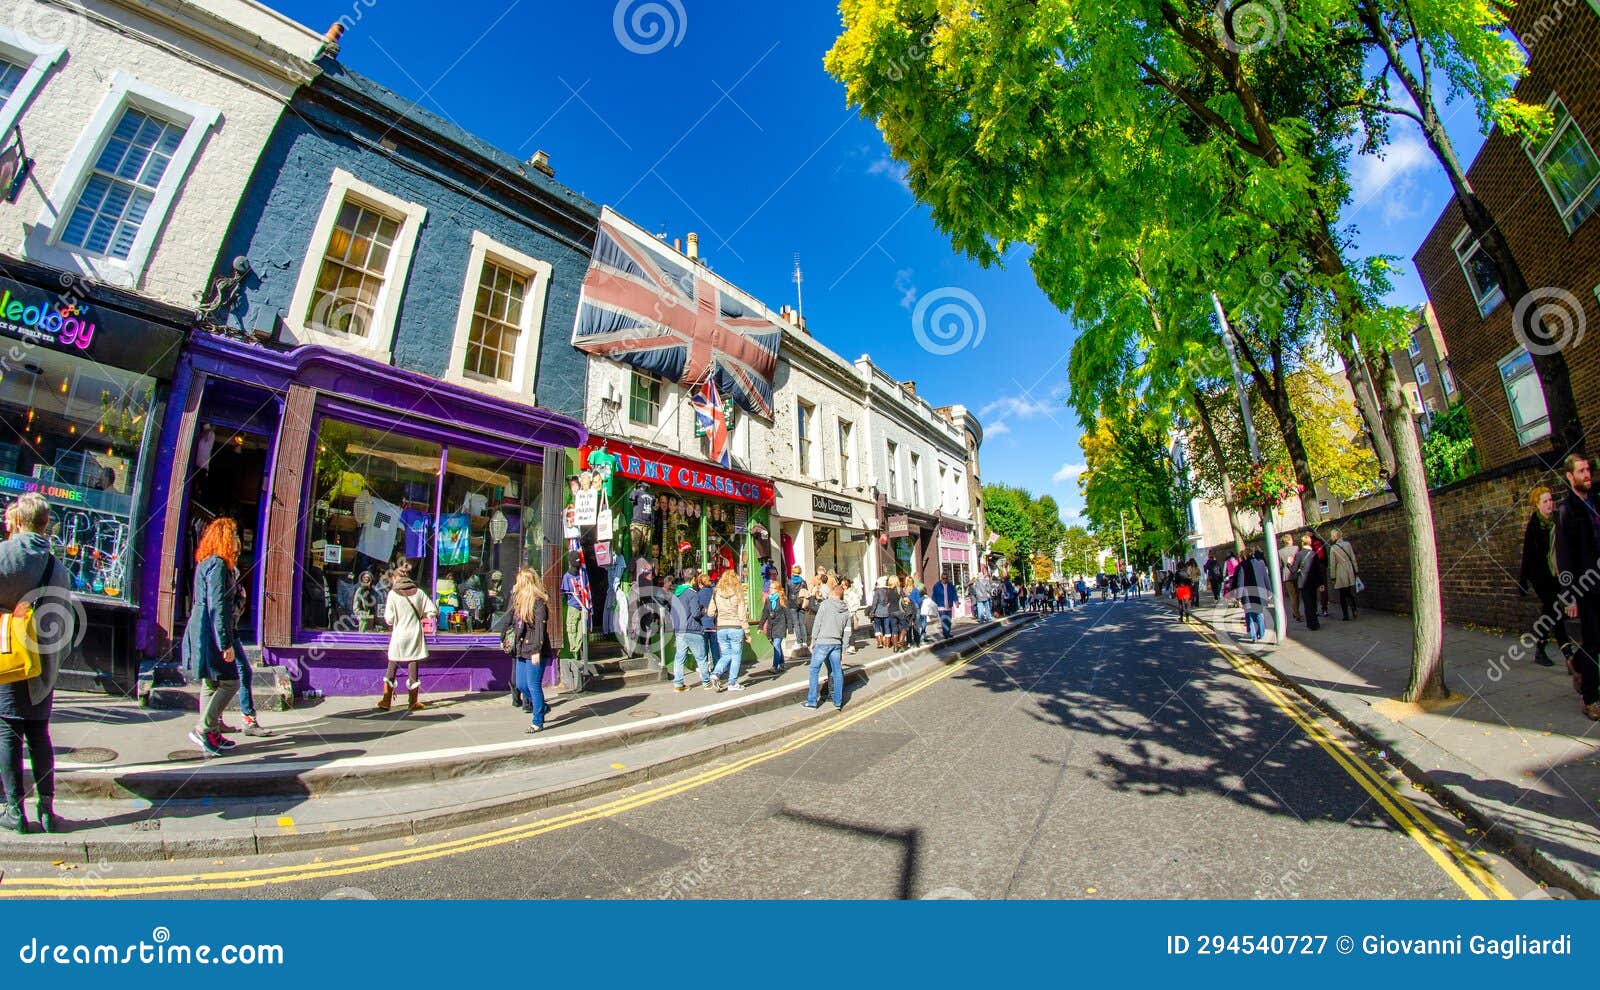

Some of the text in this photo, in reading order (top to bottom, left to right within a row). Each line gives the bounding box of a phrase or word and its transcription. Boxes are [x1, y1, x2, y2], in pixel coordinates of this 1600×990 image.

[612, 452, 673, 482] ARMY
[678, 467, 760, 501] CLASSICS
[40, 484, 83, 502] LOUNGE
[813, 496, 851, 514] Dolly Diamond
